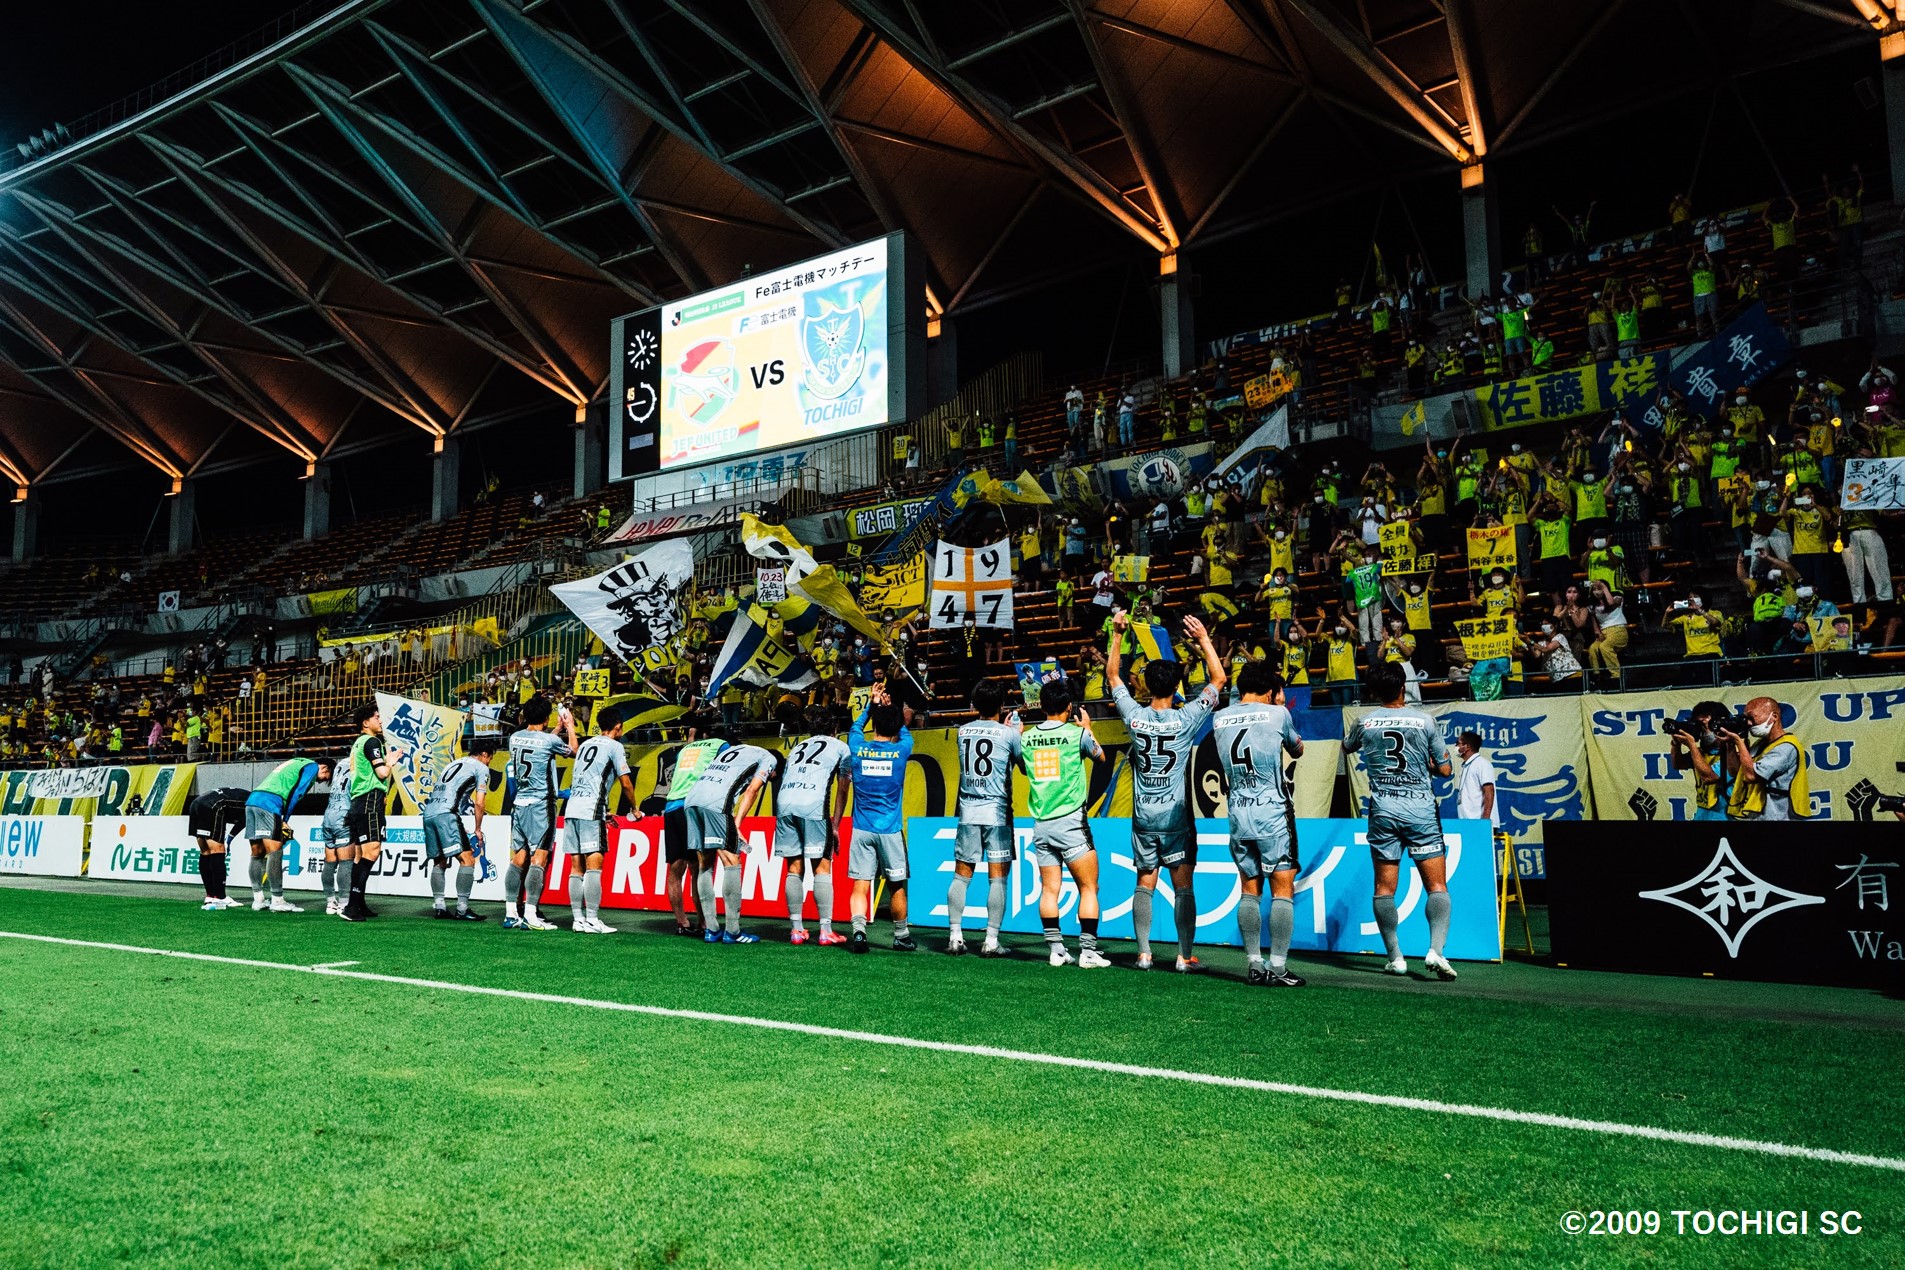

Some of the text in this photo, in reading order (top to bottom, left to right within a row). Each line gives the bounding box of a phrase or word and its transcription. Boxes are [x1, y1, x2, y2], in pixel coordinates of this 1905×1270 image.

[760, 306, 797, 325] 富士電機
[750, 360, 785, 389] VS
[1488, 355, 1658, 426] 佐藤 祥
[804, 401, 864, 425] TOCHIGI
[856, 506, 897, 536] 松岡
[1382, 525, 1405, 542] 全員
[1383, 543, 1408, 557] 戦力
[1486, 537, 1497, 555] 7
[943, 549, 999, 577] 1 9
[1383, 556, 1432, 573] 佐藤 祥
[1358, 572, 1373, 590] 19
[938, 594, 1004, 624] 4 7
[1407, 601, 1423, 610] TKC
[1489, 599, 1508, 607] TKC
[1760, 596, 1778, 605] 12
[1460, 617, 1508, 638] 根本凌
[1814, 618, 1823, 632] 7
[492, 707, 501, 719] 7
[793, 740, 824, 766] 32
[857, 749, 900, 759] ATHLETA
[1025, 737, 1069, 748] ATHLETA
[1136, 732, 1177, 775] 35
[1230, 727, 1255, 774] 4
[1382, 730, 1407, 774] 3
[512, 747, 535, 780] 15
[577, 745, 599, 773] 19
[962, 738, 993, 777] 18
[1835, 853, 1900, 912] 有
[1700, 866, 1771, 926] 和
